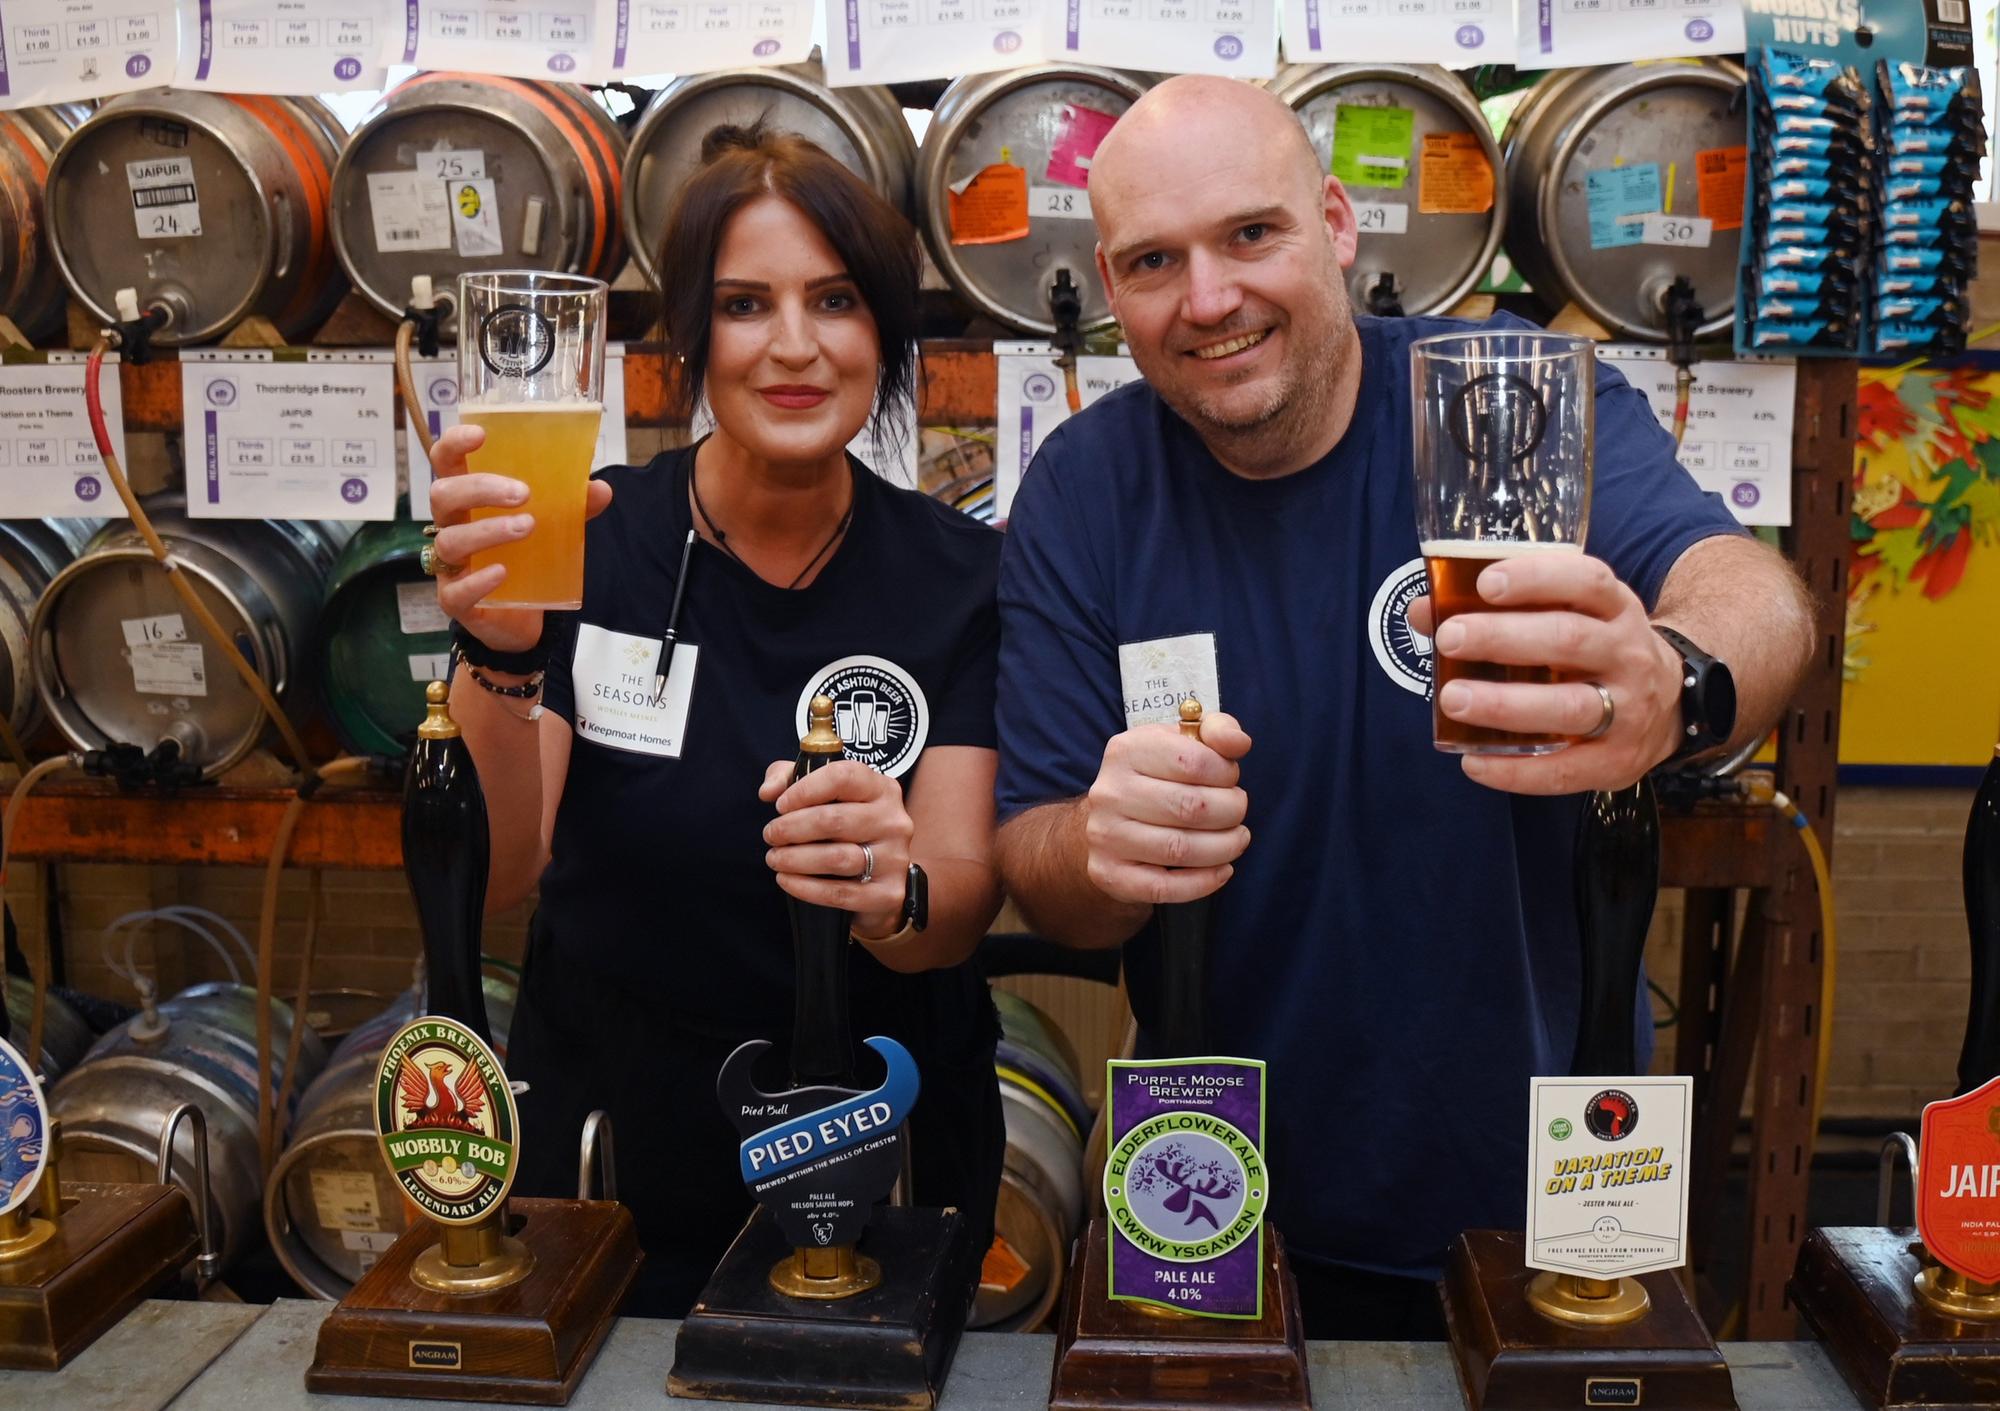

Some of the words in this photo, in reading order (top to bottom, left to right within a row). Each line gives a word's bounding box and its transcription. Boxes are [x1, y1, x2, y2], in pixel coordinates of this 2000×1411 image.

[128, 18, 146, 27] Pint
[440, 13, 468, 23] Thirds
[553, 16, 572, 25] Pint
[78, 23, 96, 33] Half
[232, 22, 259, 32] Thirds
[289, 22, 307, 31] Half
[341, 22, 359, 30] Pint
[1690, 26, 1709, 39] 22
[1773, 17, 1840, 48] NUTS
[23, 28, 50, 38] Thirds
[1461, 31, 1479, 45] 21
[26, 41, 50, 51] £1.00
[77, 36, 100, 47] £1.50
[1220, 40, 1238, 56] 20
[136, 164, 182, 180] JAIPUR
[437, 157, 464, 179] 25
[1049, 194, 1074, 212] 28
[152, 214, 178, 234] 24
[1359, 208, 1386, 228] 29
[1662, 221, 1694, 242] 30
[45, 385, 86, 397] Brewery
[255, 383, 320, 396] Thornbridge
[322, 384, 367, 397] Brewery
[1706, 385, 1754, 398] Brewery
[45, 409, 74, 418] Theme
[280, 409, 313, 419] JAIPUR
[29, 441, 46, 450] Half
[77, 441, 94, 450] Pint
[237, 441, 265, 450] Thirds
[345, 441, 363, 451] Pint
[81, 483, 97, 497] 23
[346, 485, 363, 499] 24
[1736, 488, 1755, 503] 30
[1392, 601, 1406, 617] 1st
[1401, 581, 1430, 603] ASHT
[143, 621, 164, 642] 16
[621, 673, 644, 687] THE
[1144, 677, 1170, 690] THE
[592, 682, 669, 711] SEASONS
[836, 676, 879, 693] ASHTON
[879, 682, 904, 706] BEER
[588, 721, 637, 742] Keepmoat
[639, 730, 672, 747] Homes
[383, 1026, 431, 1080] PHOENIX
[436, 1026, 500, 1088] BREWERY
[1128, 1074, 1187, 1086] PURPLE
[1191, 1075, 1245, 1087] MOOSE
[1149, 1086, 1223, 1097] BREWERY
[741, 1104, 765, 1116] Pied
[766, 1103, 789, 1116] Bull
[748, 1130, 815, 1172] PIED
[818, 1102, 892, 1145] EYED
[388, 1138, 462, 1160] WOBBLY
[468, 1142, 506, 1168] BOB
[1112, 1117, 1238, 1177] ELDERFLOWER
[1235, 1145, 1262, 1179] ALE
[755, 1176, 787, 1193] BREWED
[787, 1165, 814, 1181] WITHIN
[814, 1160, 829, 1172] THE
[829, 1151, 853, 1166] WALLS
[853, 1147, 864, 1157] OF
[864, 1134, 897, 1152] CHESTER
[1553, 1146, 1664, 1176] VARIATION
[438, 1176, 463, 1186] 6.0%
[1545, 1175, 1577, 1195] ON
[1580, 1172, 1594, 1191] A
[1601, 1162, 1673, 1188] THEME
[1940, 1164, 2000, 1198] JAIP
[403, 1177, 476, 1216] LEGENDARY
[479, 1181, 499, 1207] ALE
[809, 1193, 824, 1201] PALE
[791, 1201, 815, 1209] NELSON
[815, 1200, 838, 1208] SAUVIN
[838, 1200, 854, 1208] HOPS
[1582, 1200, 1606, 1208] JESTER
[1606, 1200, 1622, 1208] PALE
[1623, 1200, 1634, 1208] ALE
[1116, 1207, 1168, 1253] CWRW
[1172, 1209, 1256, 1258] YSGAWEN
[1155, 1270, 1188, 1284] PALE
[1191, 1271, 1216, 1284] ALE
[1168, 1287, 1202, 1300] 4.0%
[414, 1350, 457, 1360] ANGRAM
[1592, 1388, 1635, 1396] ANGRAM
